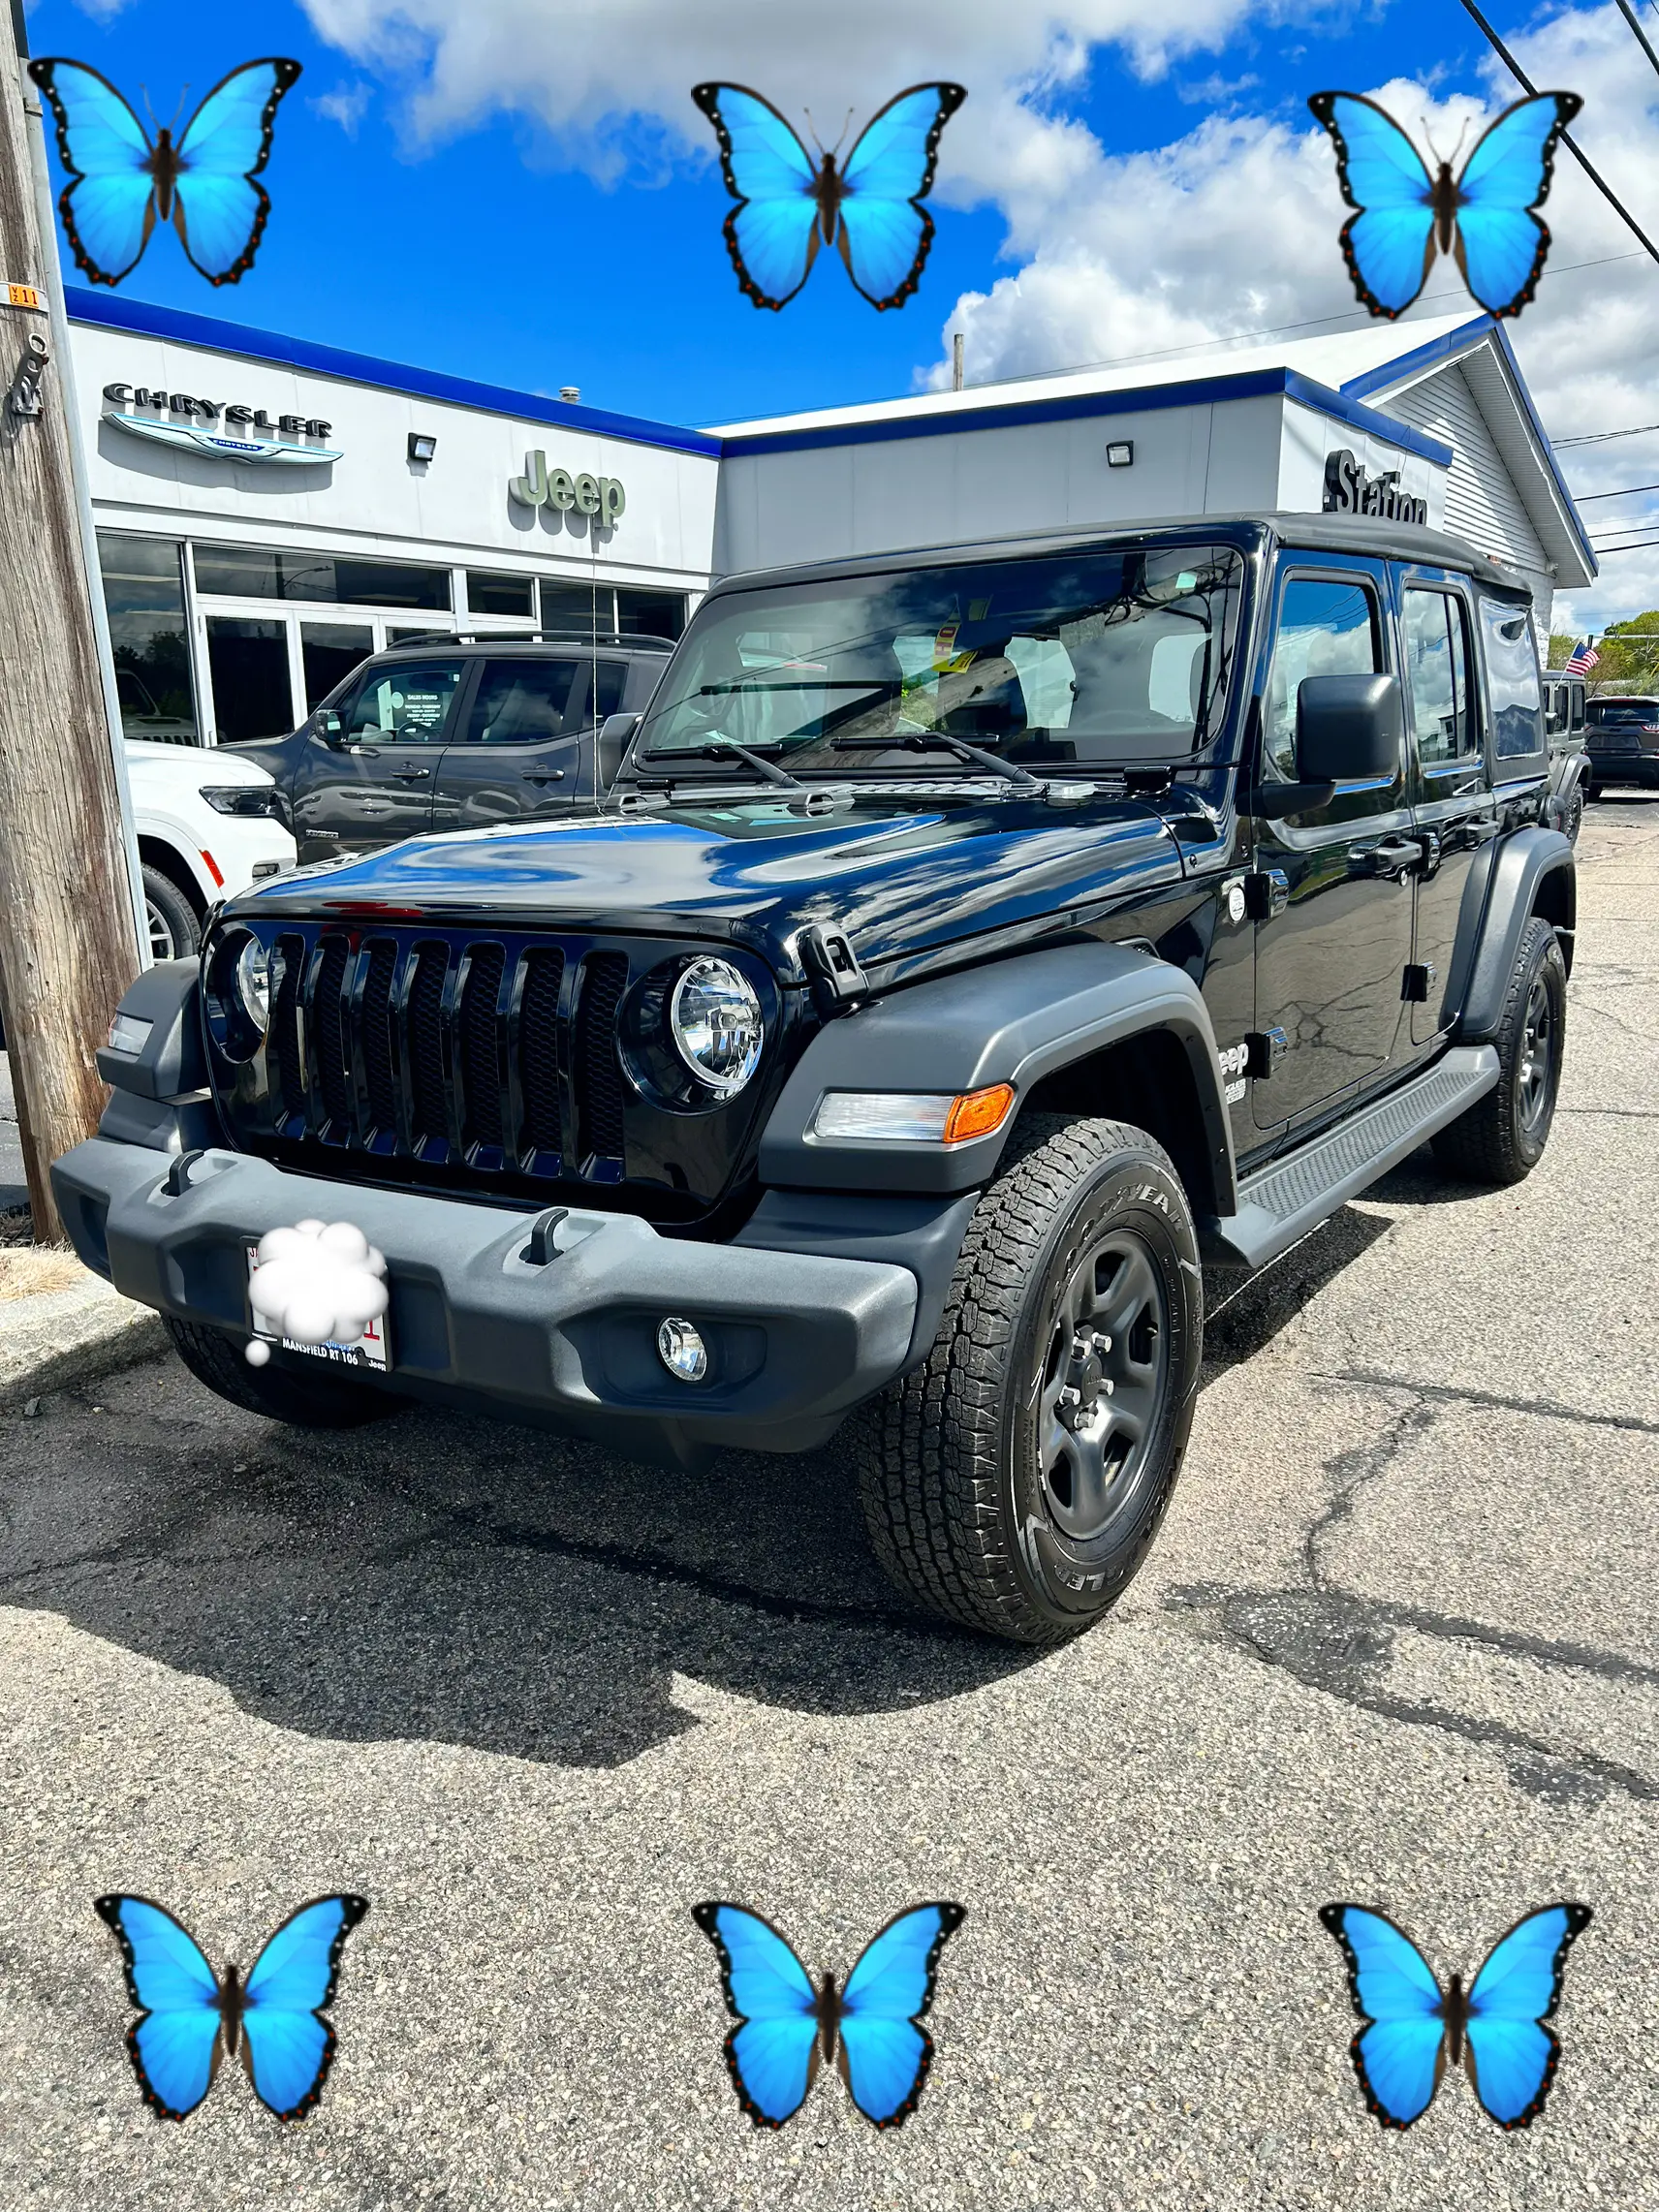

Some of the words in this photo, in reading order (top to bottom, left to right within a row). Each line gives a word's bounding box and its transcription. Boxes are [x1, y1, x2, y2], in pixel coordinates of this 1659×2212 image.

[22, 290, 37, 304] 11
[103, 383, 332, 438] CHRYSLER
[213, 439, 259, 451] CHRYSLER
[509, 450, 626, 528] Jeep
[1323, 449, 1427, 526] Station
[1218, 1044, 1249, 1075] eep
[282, 1337, 328, 1358] MANSFIELD
[329, 1347, 340, 1361] RT
[341, 1351, 359, 1365] 106
